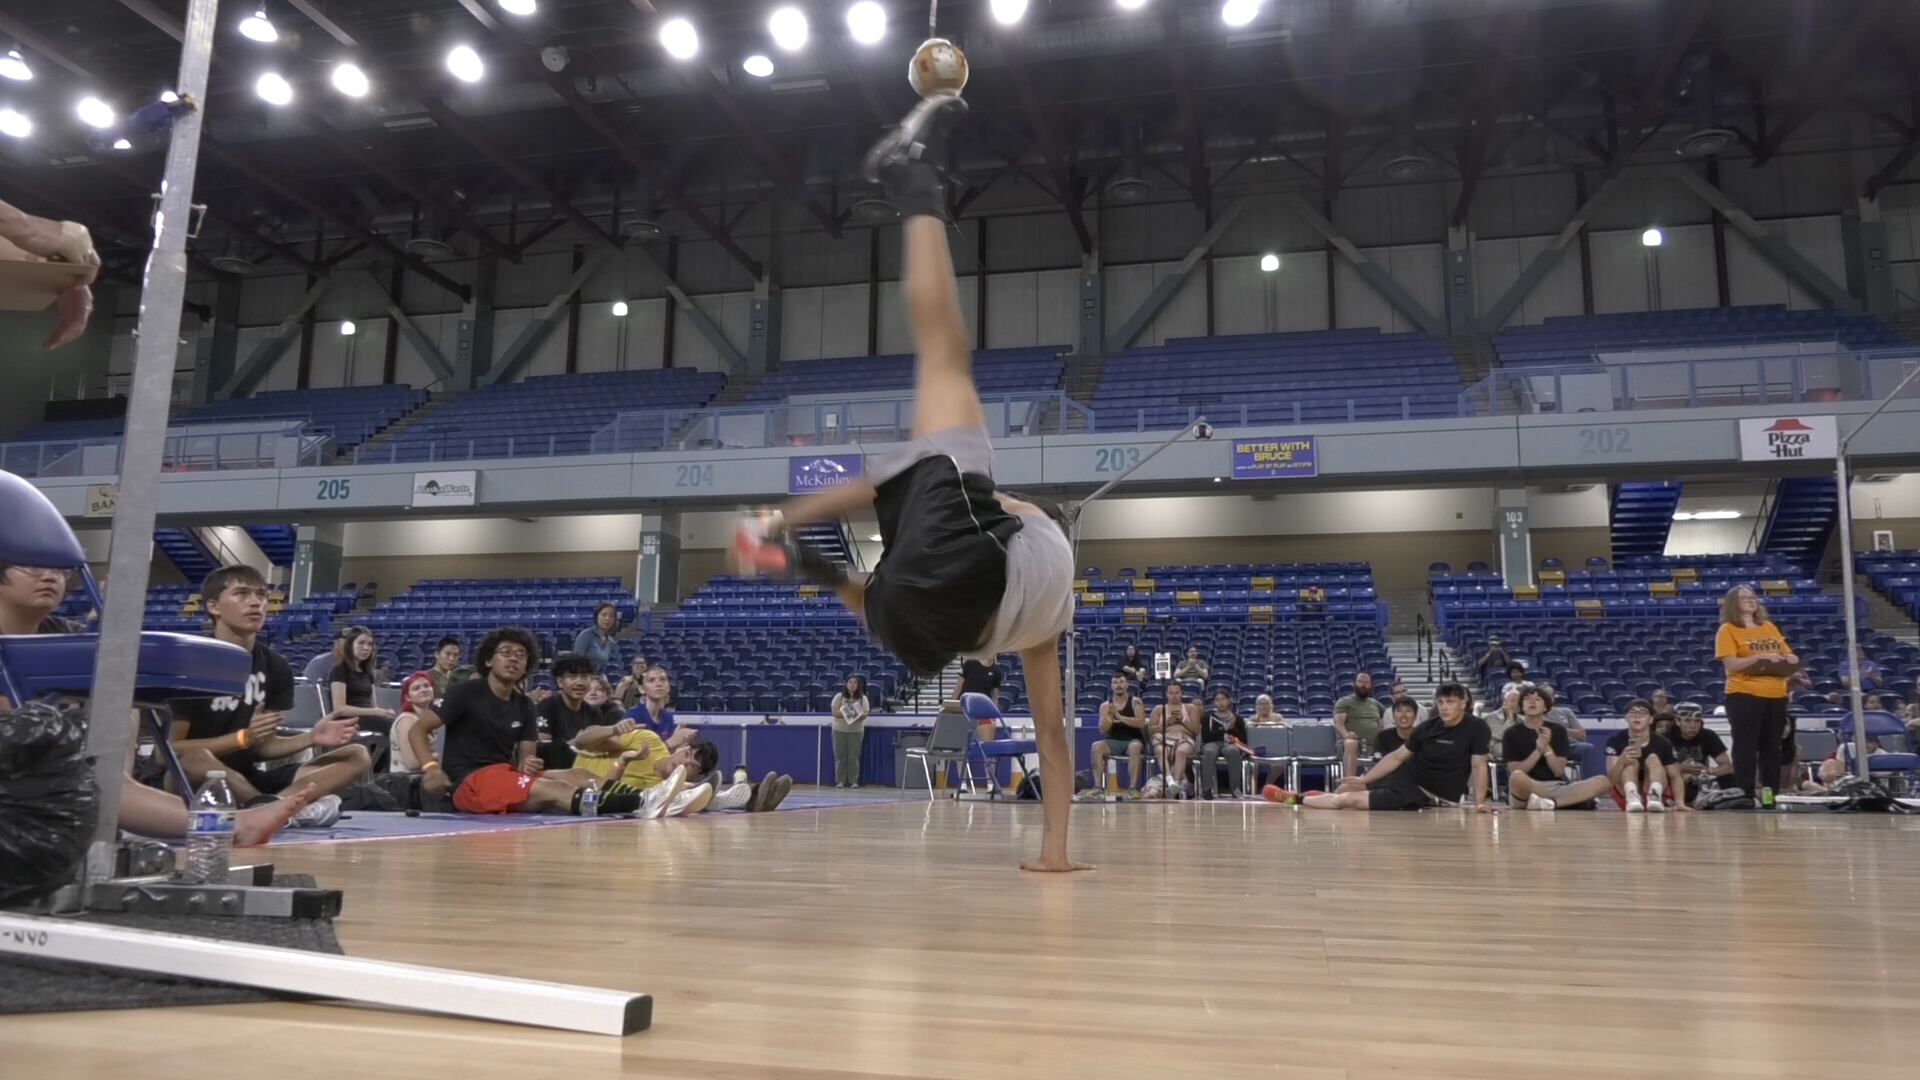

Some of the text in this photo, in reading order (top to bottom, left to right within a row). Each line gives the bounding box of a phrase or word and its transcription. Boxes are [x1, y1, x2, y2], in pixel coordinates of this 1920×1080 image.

[1580, 427, 1632, 453] 202
[1768, 432, 1811, 446] Pizza
[1236, 441, 1310, 453] BETTER WITH
[1770, 444, 1805, 457] Hut
[1095, 447, 1140, 472] 203
[1254, 451, 1292, 461] BRUCE
[676, 465, 714, 488] 204
[317, 479, 350, 500] 205
[1505, 511, 1522, 522] 103
[643, 535, 656, 545] 105
